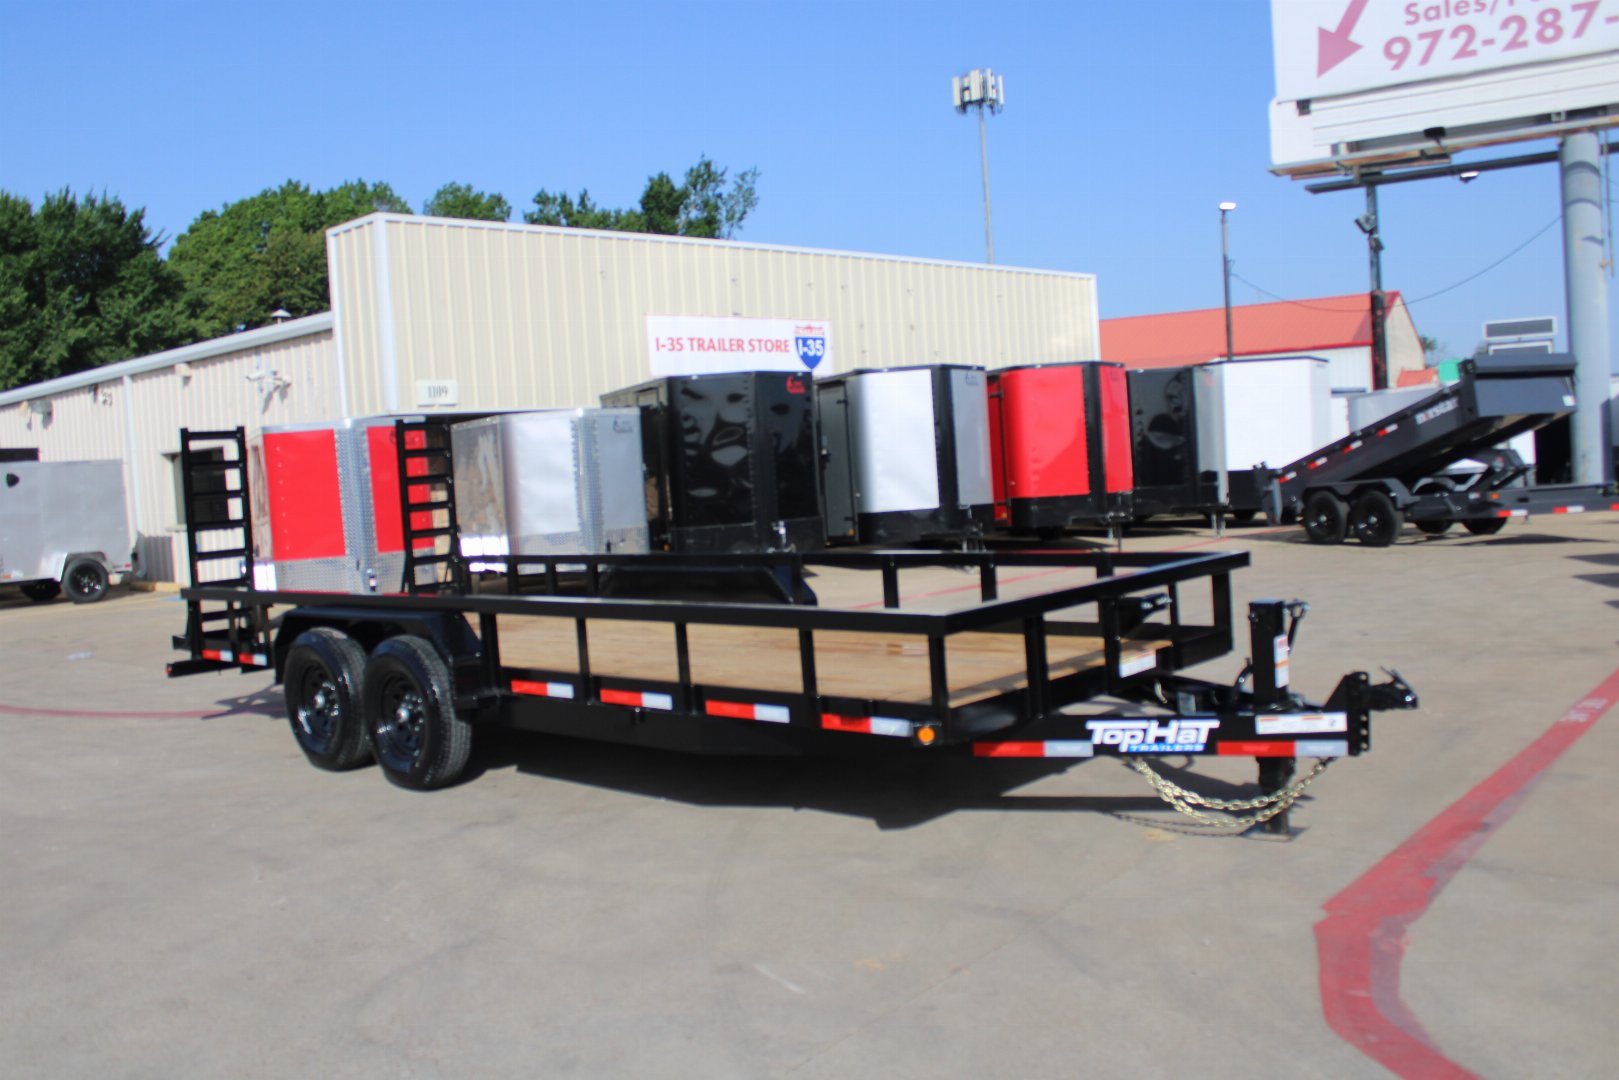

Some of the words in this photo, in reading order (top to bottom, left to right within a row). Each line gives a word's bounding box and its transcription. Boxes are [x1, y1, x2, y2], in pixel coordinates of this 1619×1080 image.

[655, 338, 684, 352] I-35
[687, 338, 745, 353] TRAILER
[748, 339, 790, 353] STORE
[797, 338, 824, 357] I-35
[1129, 743, 1205, 752] TRAILERS
